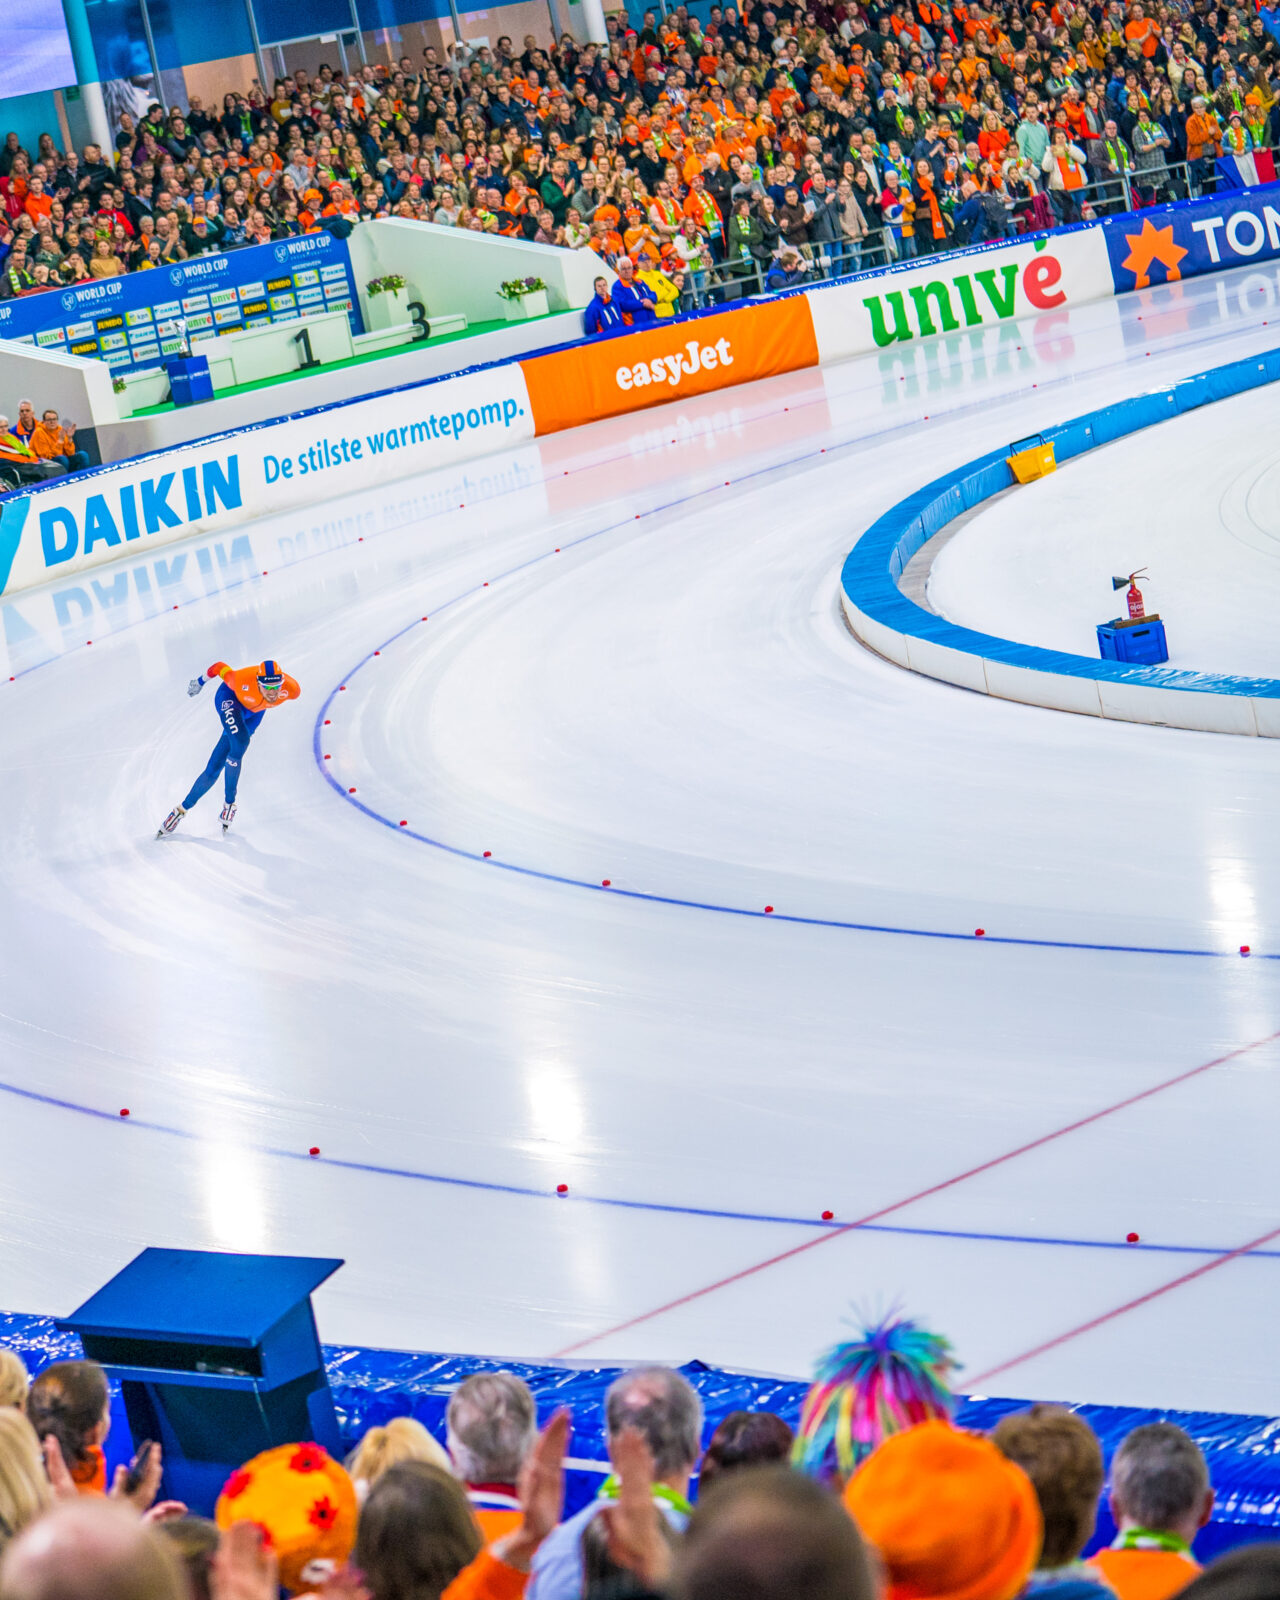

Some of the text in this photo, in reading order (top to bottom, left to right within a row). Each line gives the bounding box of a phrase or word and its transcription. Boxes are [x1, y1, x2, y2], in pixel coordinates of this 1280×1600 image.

[287, 236, 331, 254] WORLD CUP
[183, 262, 212, 278] WORLD
[213, 258, 228, 271] CUP
[76, 286, 106, 302] WORLD
[107, 282, 122, 295] CUP
[863, 240, 1067, 347] univé
[407, 302, 431, 342] 3
[294, 328, 321, 370] 1
[616, 337, 734, 390] easyJet
[263, 398, 525, 483] De stilste warmtepomp.
[39, 455, 243, 568] DAIKIN
[224, 708, 239, 735] kpn
